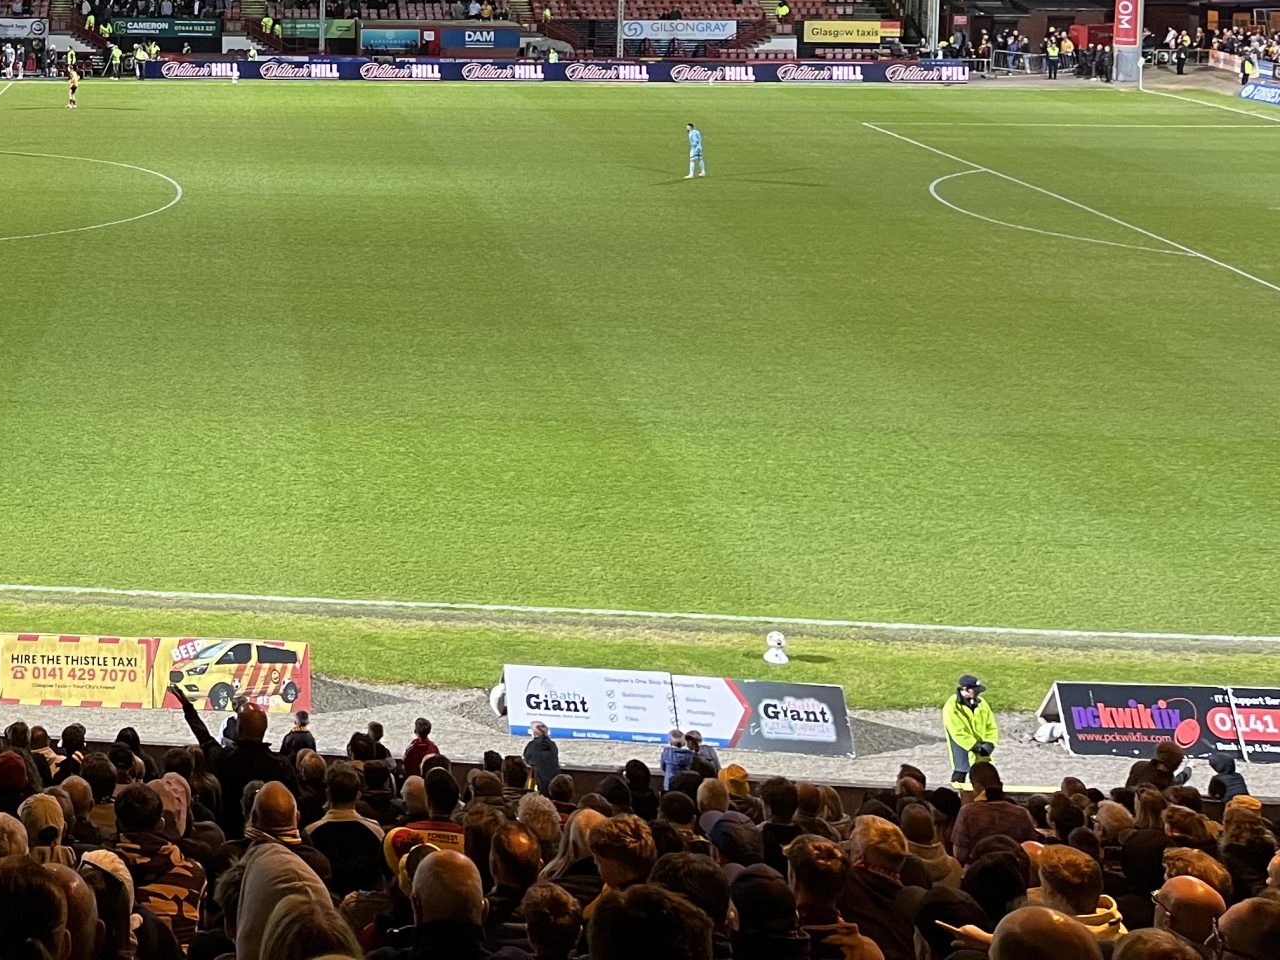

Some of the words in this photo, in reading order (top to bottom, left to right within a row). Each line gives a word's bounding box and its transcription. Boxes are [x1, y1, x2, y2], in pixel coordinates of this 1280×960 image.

[651, 22, 728, 32] GILSONGRAY
[811, 27, 854, 38] Glasgow
[856, 28, 879, 37] taxis
[465, 31, 494, 42] DAM
[161, 62, 211, 77] William
[260, 62, 311, 78] William
[311, 64, 339, 77] HILL
[360, 62, 411, 78] William
[412, 64, 441, 78] HILL
[462, 63, 514, 78] William
[515, 65, 544, 79] HILL
[565, 63, 619, 80] William
[619, 65, 649, 79] HILL
[670, 64, 725, 81] William
[725, 66, 755, 80] HILL
[777, 64, 832, 81] William
[832, 65, 863, 80] HILL
[885, 64, 940, 81] William
[11, 654, 37, 664] HIRE
[40, 655, 62, 665] THE
[65, 655, 108, 666] THISTLE
[112, 657, 137, 667] TAXI
[32, 666, 64, 680] 0141
[67, 667, 96, 681] 429
[99, 668, 137, 683] 7070
[526, 693, 588, 713] Giant
[550, 690, 580, 700] Bath
[1214, 695, 1223, 703] IT
[788, 700, 820, 710] Bath
[1071, 699, 1182, 730] pckwikfix
[1077, 731, 1171, 744] www.pckwikfix.com
